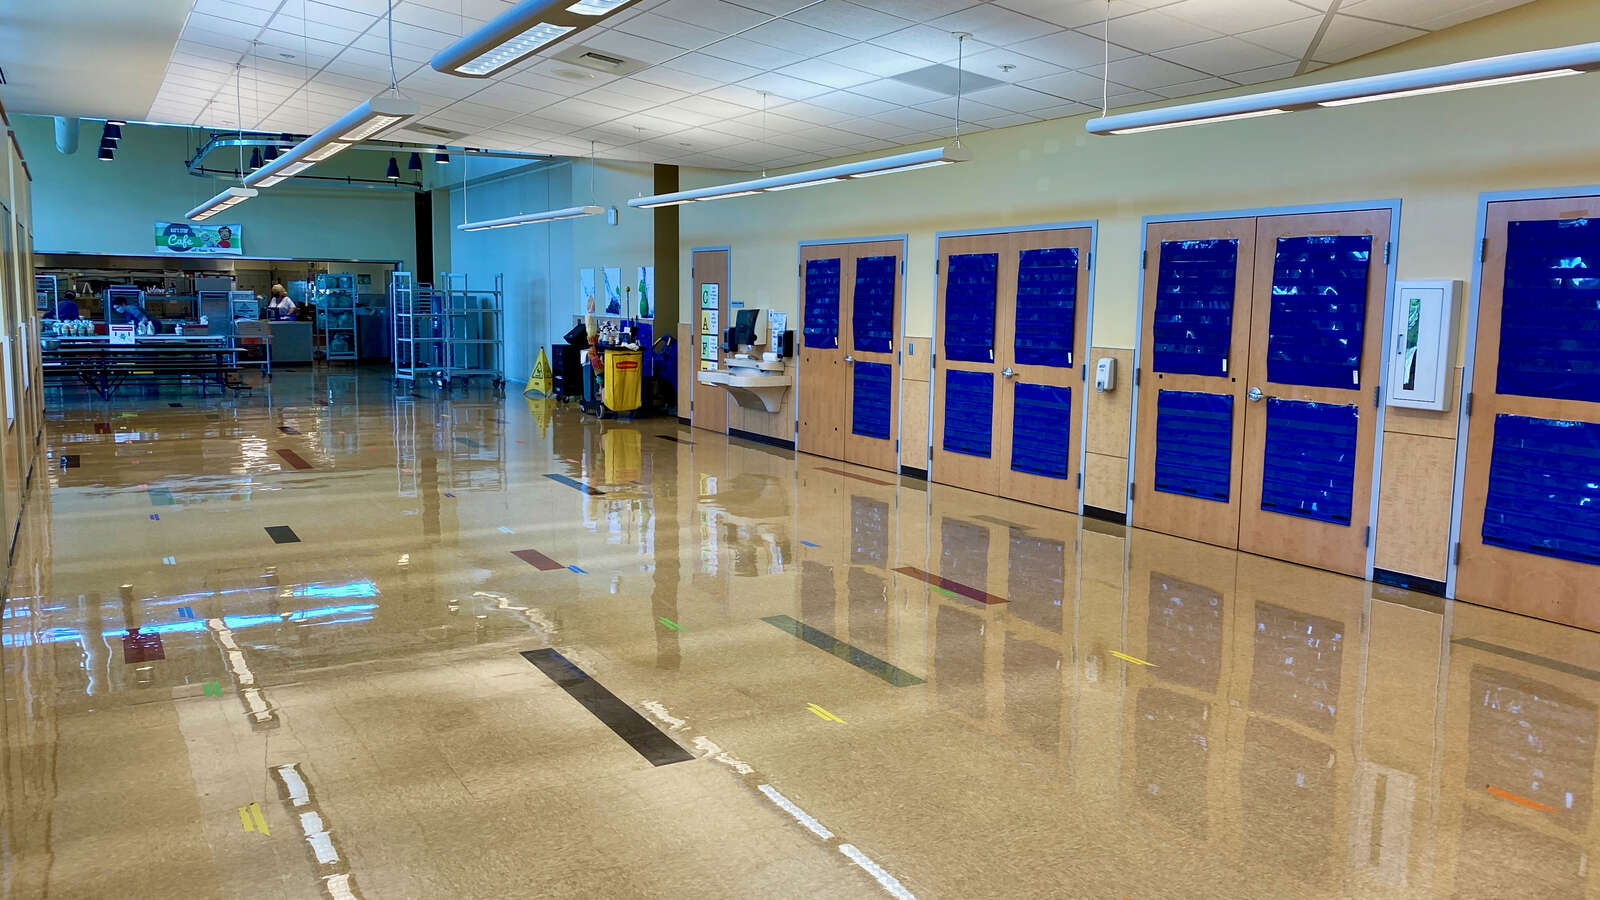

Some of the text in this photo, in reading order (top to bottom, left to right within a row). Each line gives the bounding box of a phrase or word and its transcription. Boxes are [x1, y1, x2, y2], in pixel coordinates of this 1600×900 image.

[168, 234, 193, 248] Cafe
[702, 290, 709, 304] C
[702, 317, 709, 331] A
